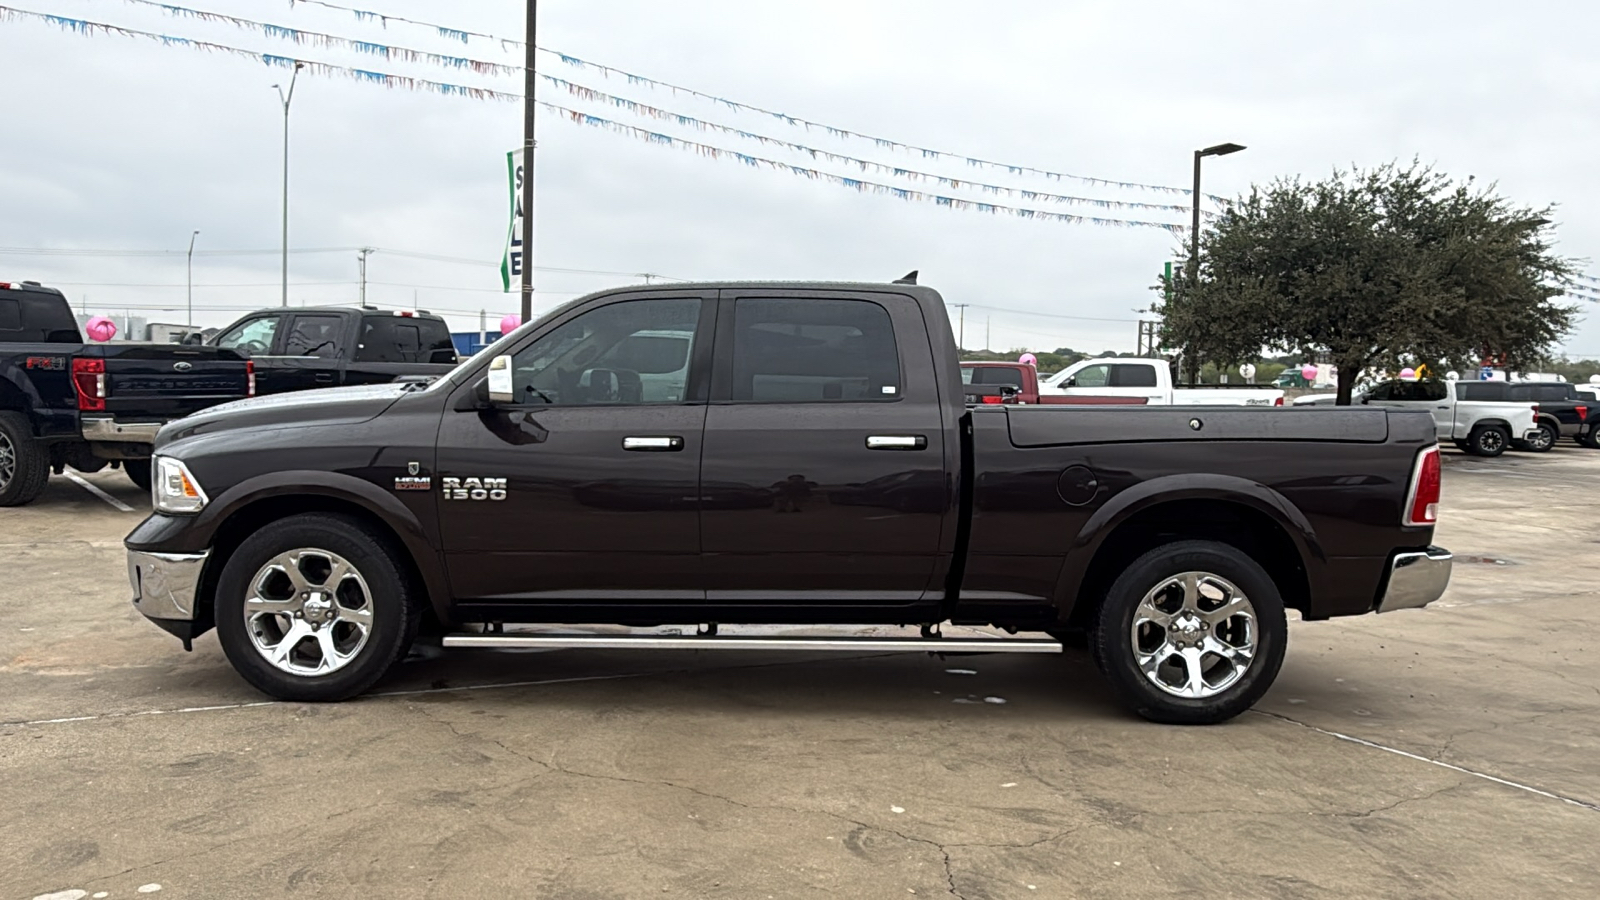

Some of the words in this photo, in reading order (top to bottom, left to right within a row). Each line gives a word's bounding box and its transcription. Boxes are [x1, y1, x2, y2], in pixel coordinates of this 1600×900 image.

[510, 165, 524, 276] SALE
[26, 357, 66, 370] FX4
[442, 477, 507, 489] RAM
[442, 489, 507, 500] 1500
